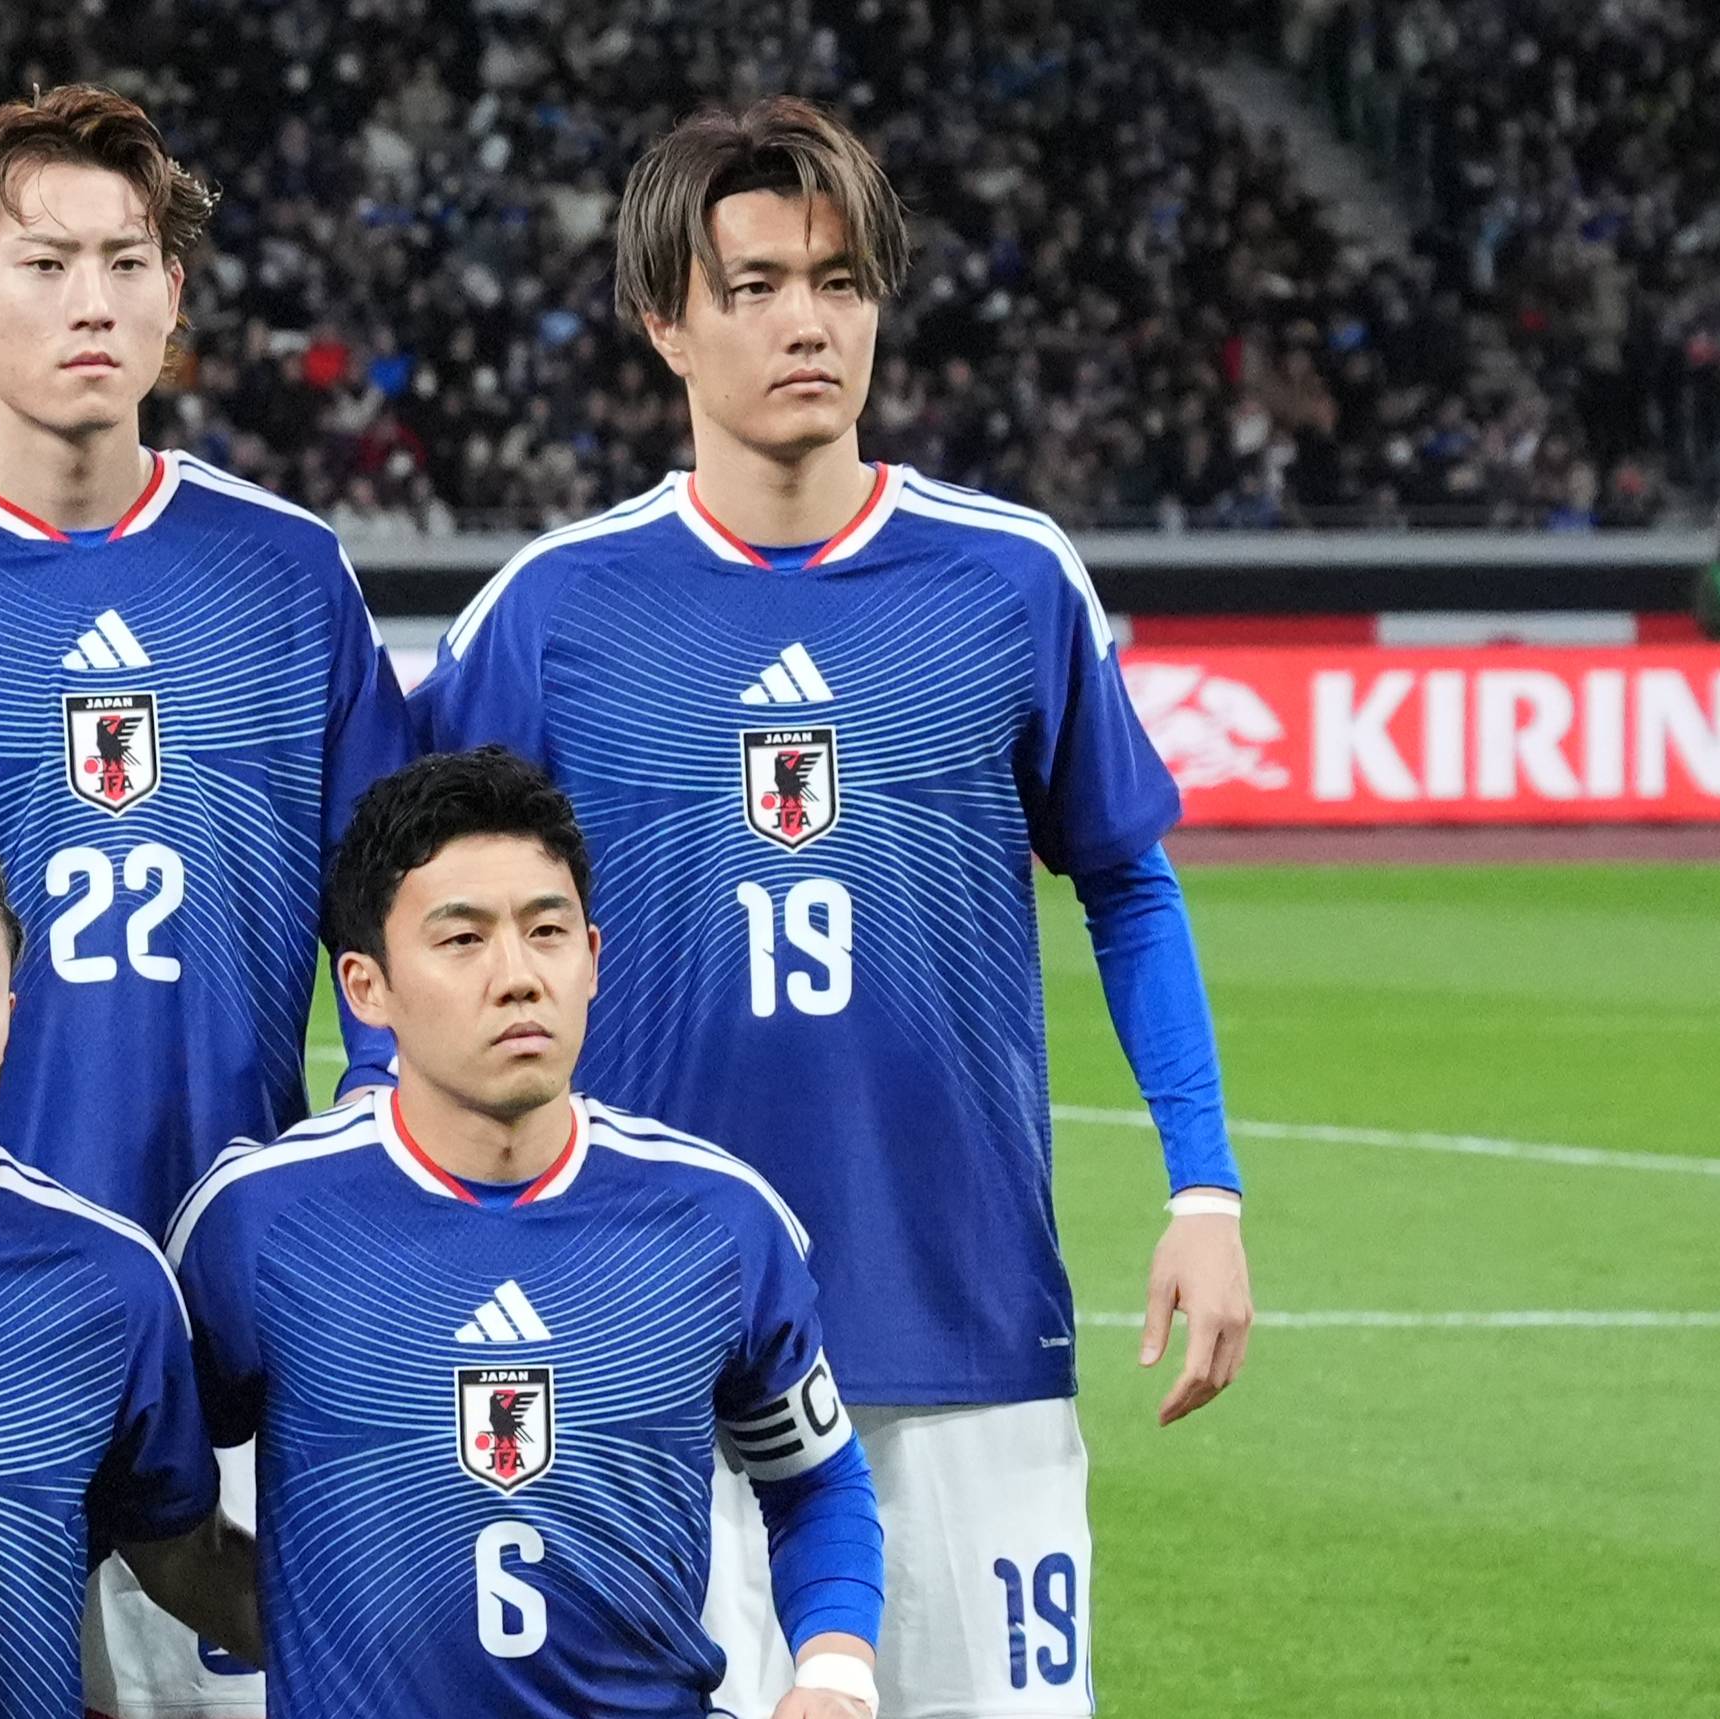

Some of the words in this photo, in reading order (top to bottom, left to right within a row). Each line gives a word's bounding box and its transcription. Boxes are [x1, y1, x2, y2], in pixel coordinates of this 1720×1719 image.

[86, 697, 133, 709] JAPAN
[764, 732, 812, 744] JAPAN
[1312, 669, 1720, 801] KIRIN
[95, 775, 134, 793] JFA
[772, 811, 812, 829] JFA
[45, 843, 185, 983] 22
[737, 878, 853, 1018] 19
[479, 1371, 528, 1382] JAPAN
[486, 1452, 526, 1470] JFA
[475, 1520, 548, 1658] 6
[993, 1552, 1077, 1690] 19
